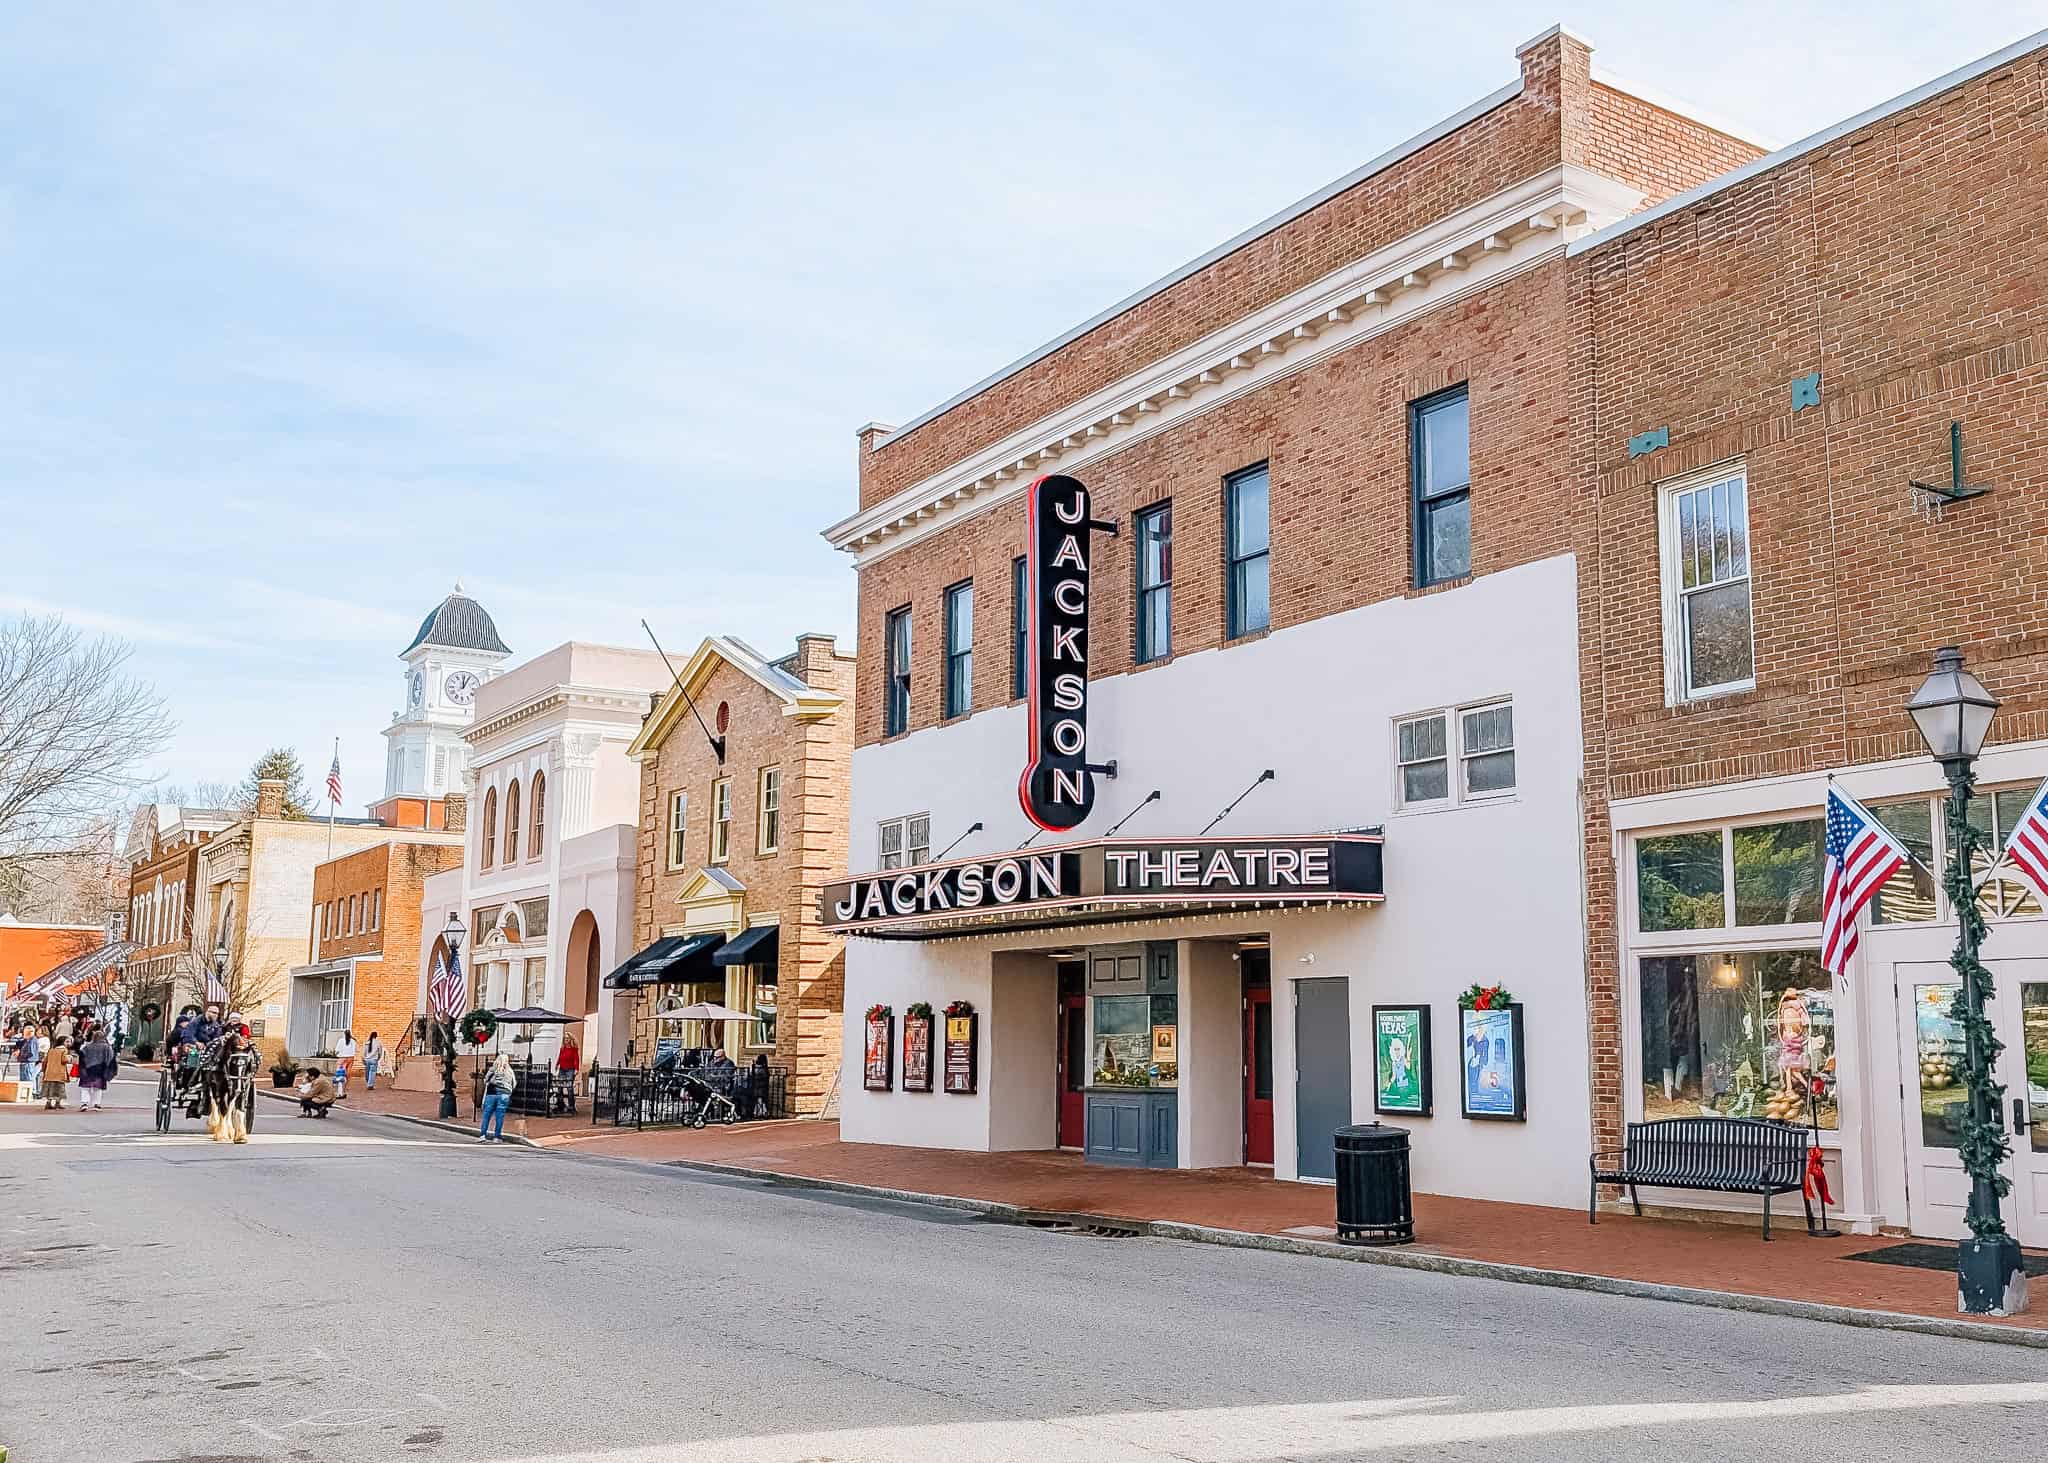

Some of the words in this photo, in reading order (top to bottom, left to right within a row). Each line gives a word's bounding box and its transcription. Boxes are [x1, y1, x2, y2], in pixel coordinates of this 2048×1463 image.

[1052, 491, 1087, 805] JACKSON
[835, 851, 1062, 921] JACKSON
[1105, 847, 1330, 888] THEATRE
[1380, 1022, 1407, 1035] TEXAS
